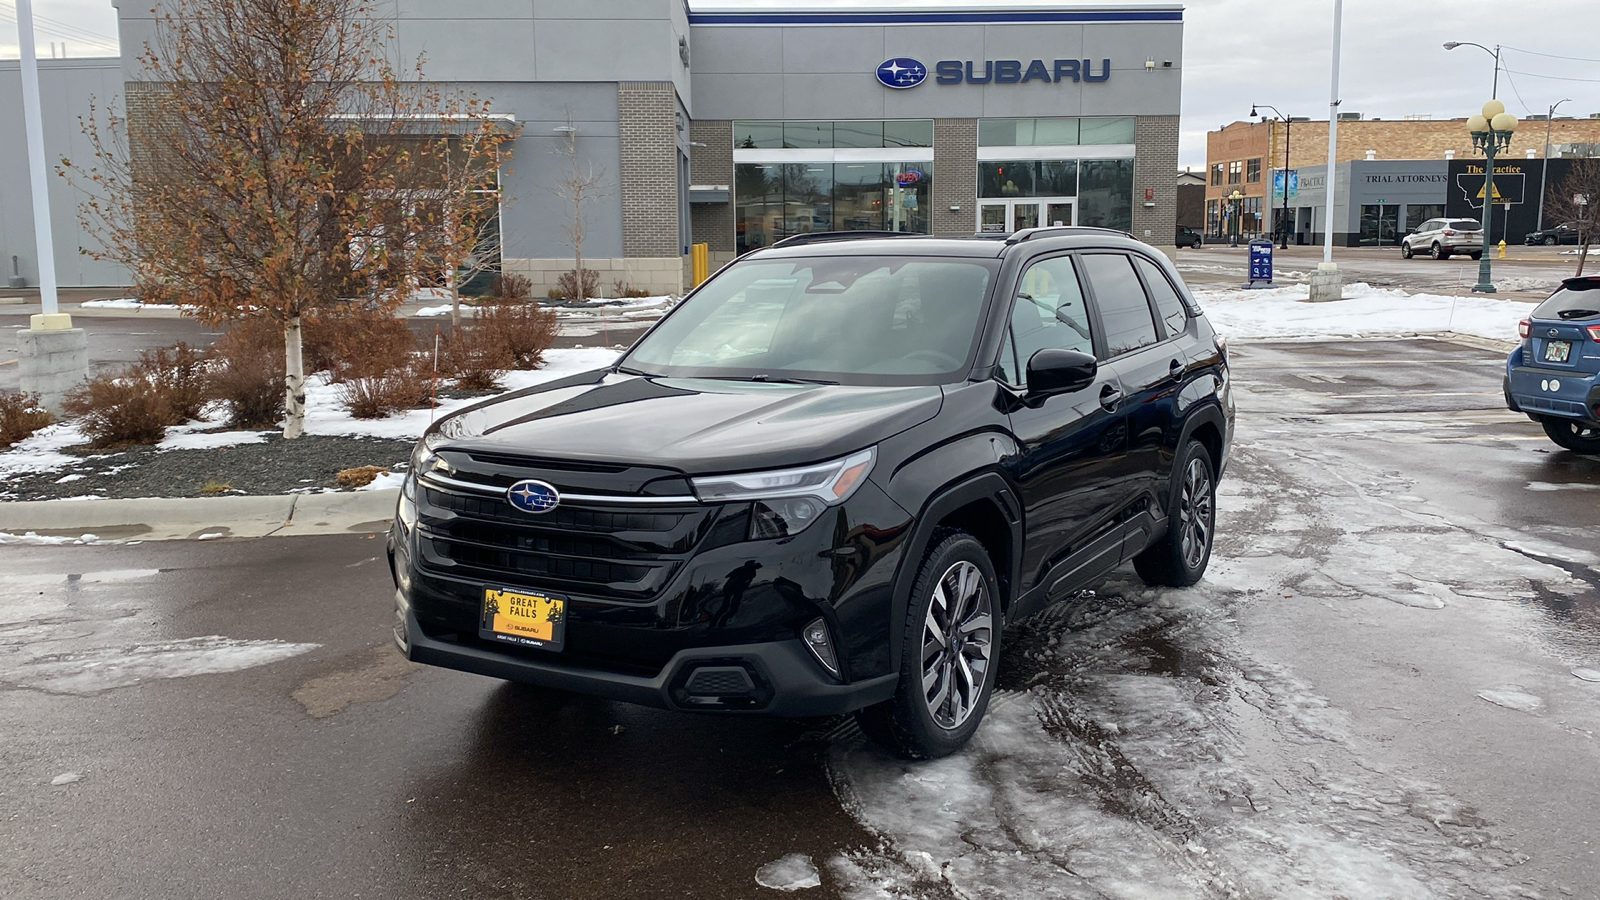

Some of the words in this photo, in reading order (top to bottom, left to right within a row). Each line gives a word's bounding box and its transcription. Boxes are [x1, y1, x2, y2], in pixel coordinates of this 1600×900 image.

[936, 59, 1111, 85] SUBARU
[1466, 165, 1484, 174] The
[1485, 165, 1521, 174] ractice
[896, 172, 918, 182] OPEN
[1300, 176, 1325, 188] PRACTICE
[1365, 175, 1393, 183] TRIAL
[1395, 174, 1448, 183] ATTORNEYS
[510, 597, 538, 608] GREAT
[510, 606, 537, 618] FALLS
[514, 626, 539, 634] SUBARU
